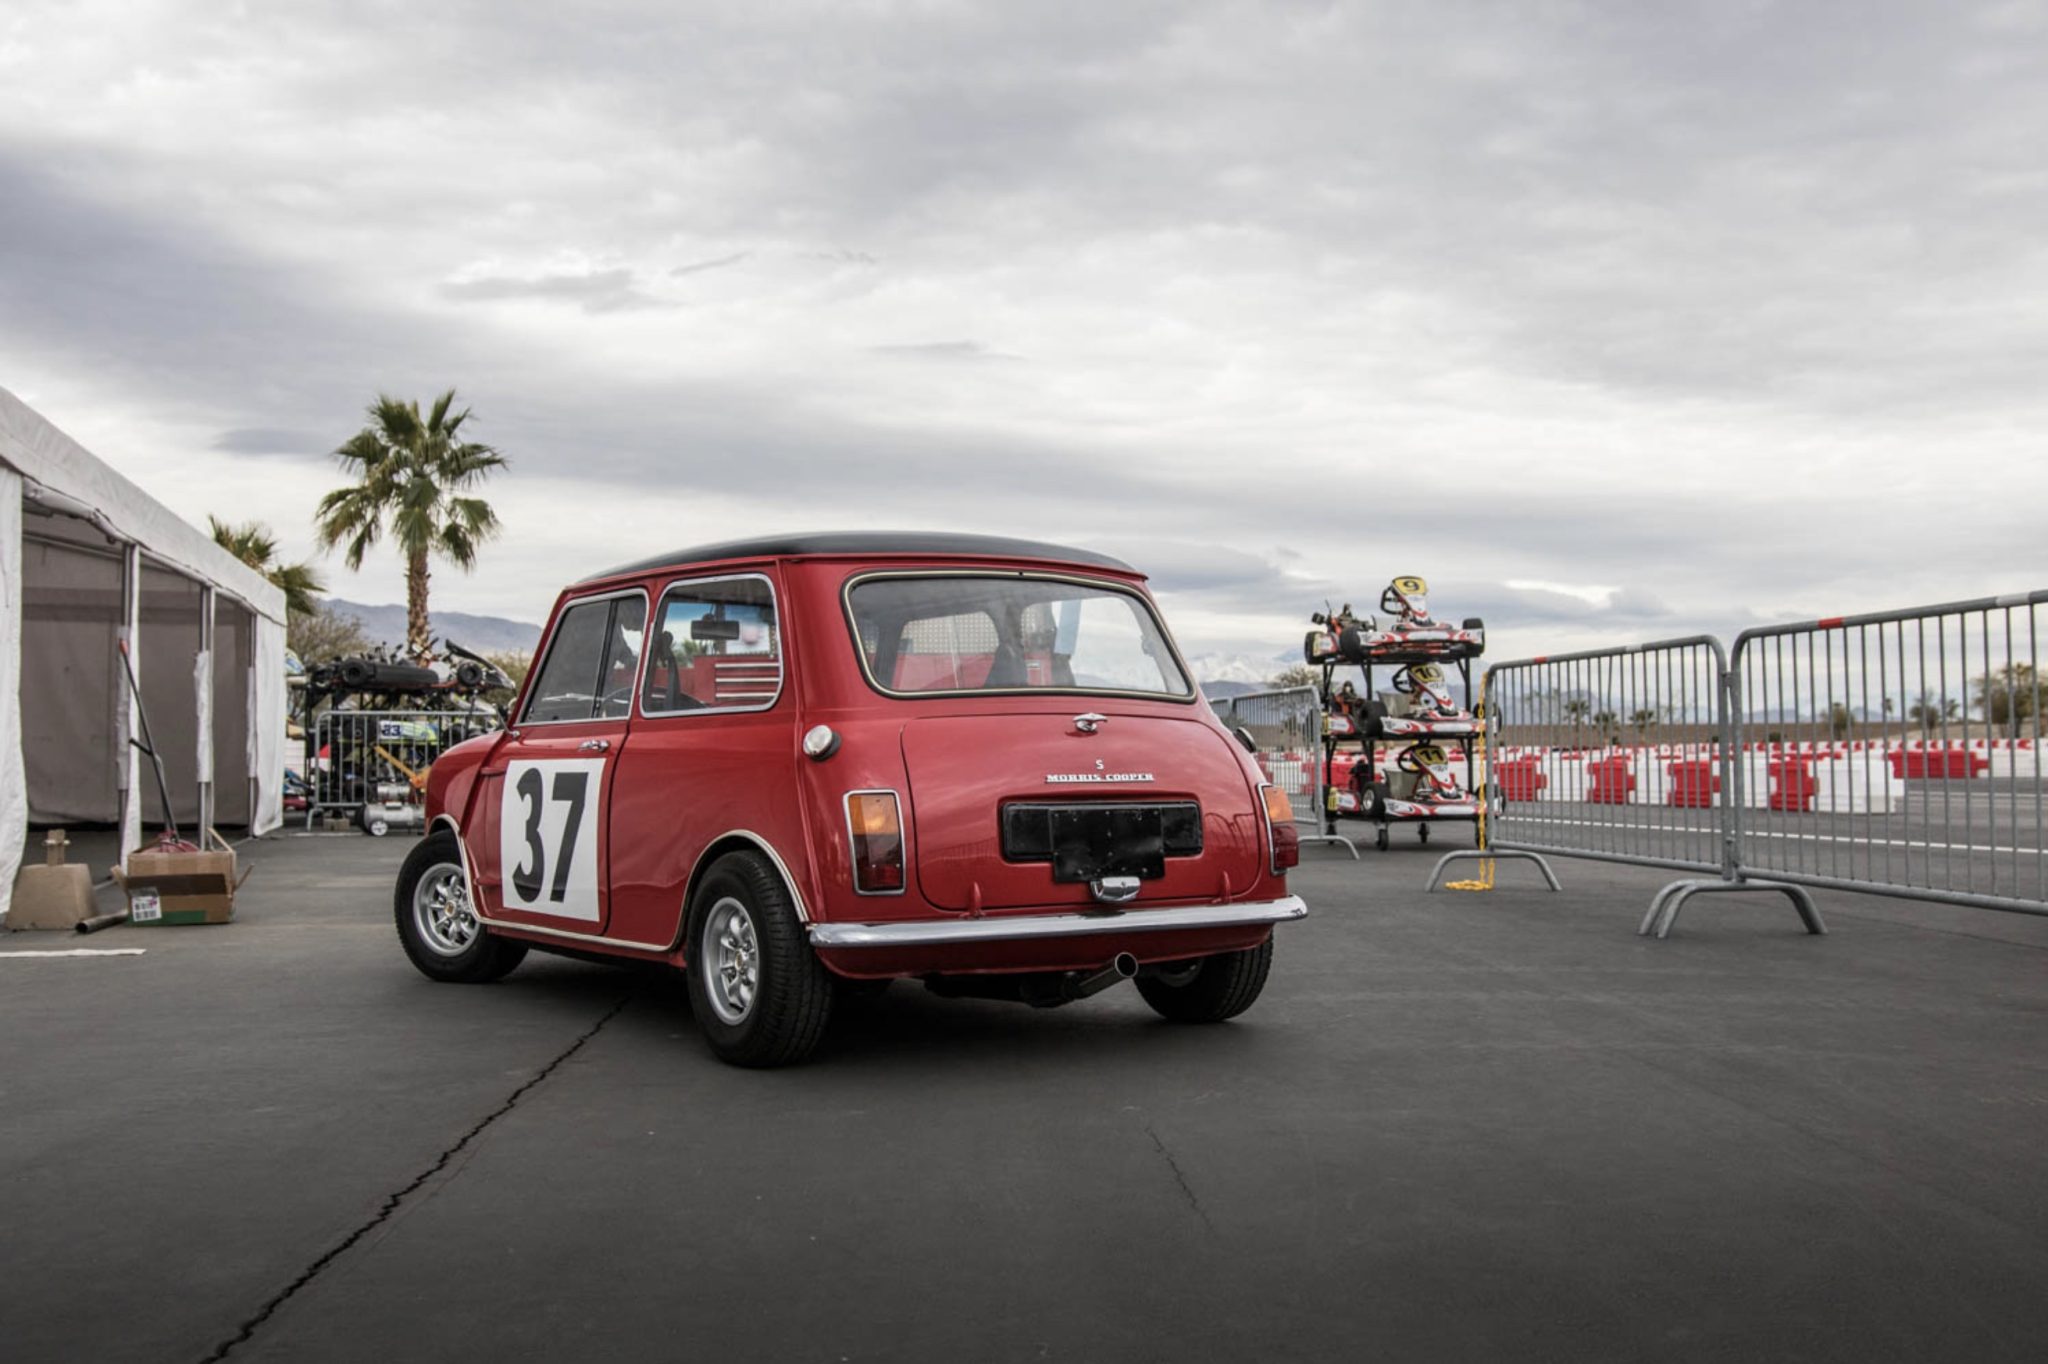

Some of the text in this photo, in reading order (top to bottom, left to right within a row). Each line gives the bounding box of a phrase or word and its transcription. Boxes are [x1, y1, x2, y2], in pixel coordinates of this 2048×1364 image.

[1403, 580, 1420, 591] 9
[1415, 666, 1441, 679] 10
[1420, 750, 1444, 761] 11
[1095, 759, 1104, 770] S
[1047, 773, 1154, 783] MORRIS COOPER
[512, 767, 589, 903] 37
